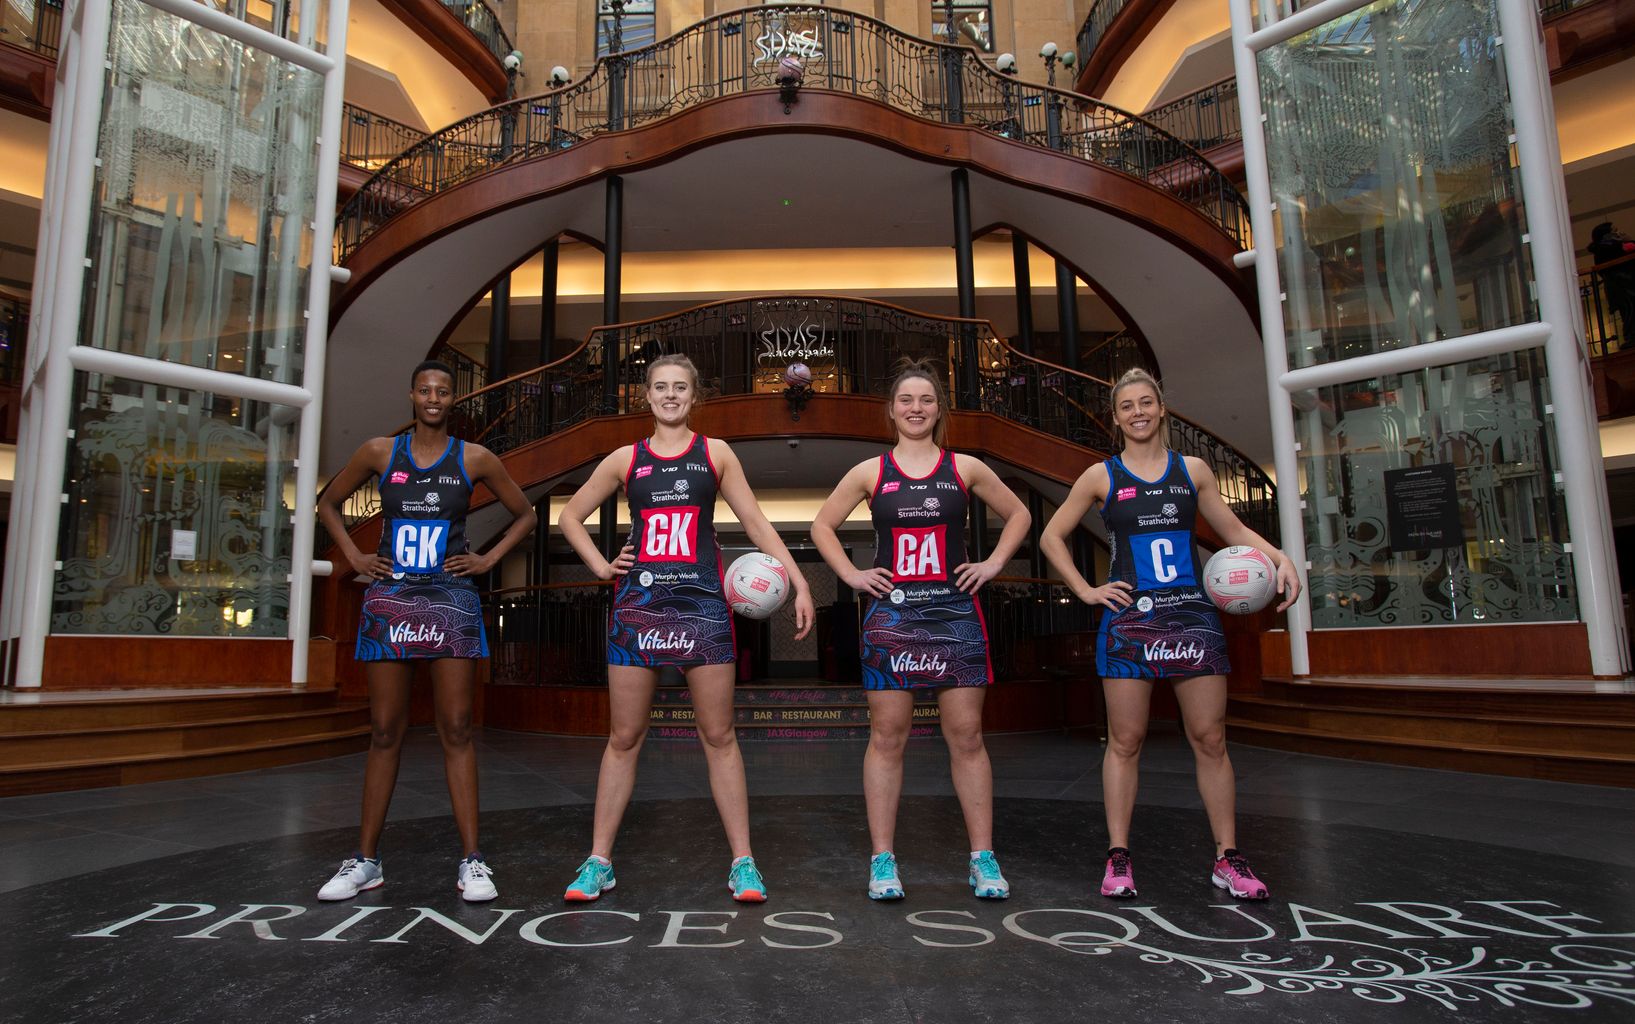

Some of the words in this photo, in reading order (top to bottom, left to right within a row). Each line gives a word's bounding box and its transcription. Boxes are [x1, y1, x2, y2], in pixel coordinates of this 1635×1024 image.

[402, 504, 440, 513] Strathclyde
[652, 493, 690, 502] Strathclyde
[898, 510, 940, 518] Strathclyde
[1138, 517, 1179, 527] Strathclyde
[395, 524, 443, 569] GK
[646, 512, 693, 557] GK
[896, 531, 941, 576] GA
[1150, 538, 1178, 583] C
[655, 572, 679, 581] Murphy
[678, 571, 699, 579] Wealth
[906, 588, 930, 598] Murphy
[930, 587, 951, 596] Wealth
[1155, 594, 1180, 604] Murphy
[1180, 592, 1203, 600] Wealth
[390, 620, 445, 649] Vitality
[638, 628, 695, 656] Vitality
[890, 650, 947, 678] Vitality
[1143, 639, 1205, 666] Vitality
[753, 711, 773, 720] BAR
[782, 710, 842, 720] RESTAURANT
[71, 902, 843, 949] PRINCES
